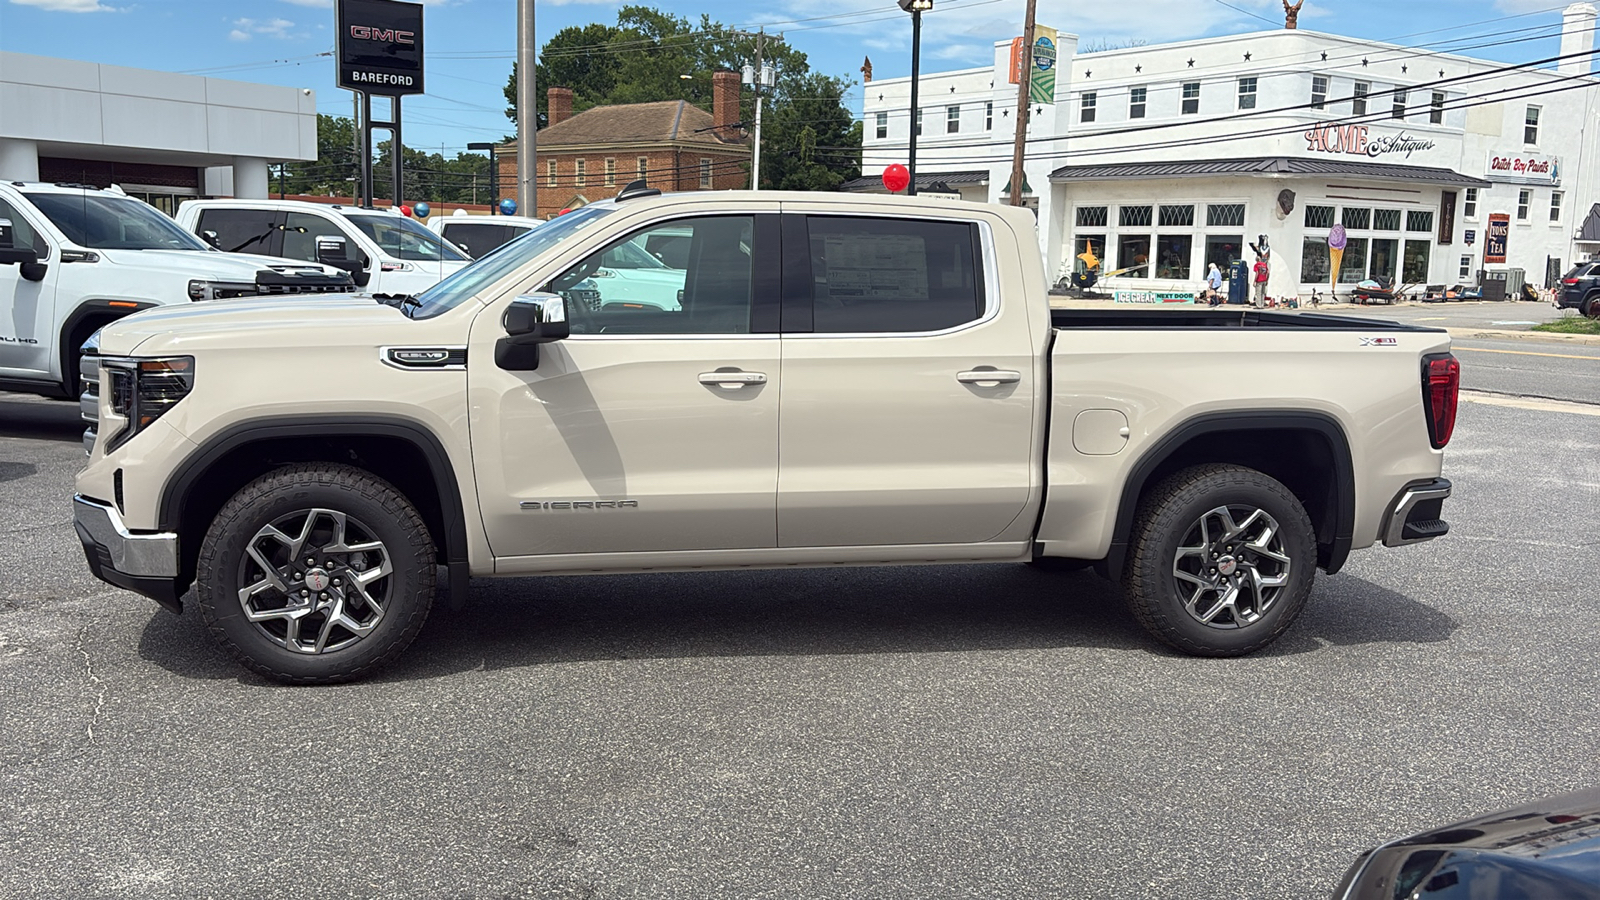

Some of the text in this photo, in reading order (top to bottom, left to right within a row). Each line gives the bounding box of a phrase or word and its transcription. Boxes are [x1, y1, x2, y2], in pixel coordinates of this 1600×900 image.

[350, 25, 415, 45] GMC
[352, 71, 413, 86] BAREFORD
[1304, 121, 1436, 159] ACME Antiques
[1491, 156, 1550, 175] Dutch Boy Paints
[1490, 241, 1504, 254] TEA
[1117, 292, 1130, 303] ICE
[1131, 292, 1156, 303] CREAM
[519, 500, 638, 510] SIERRA
